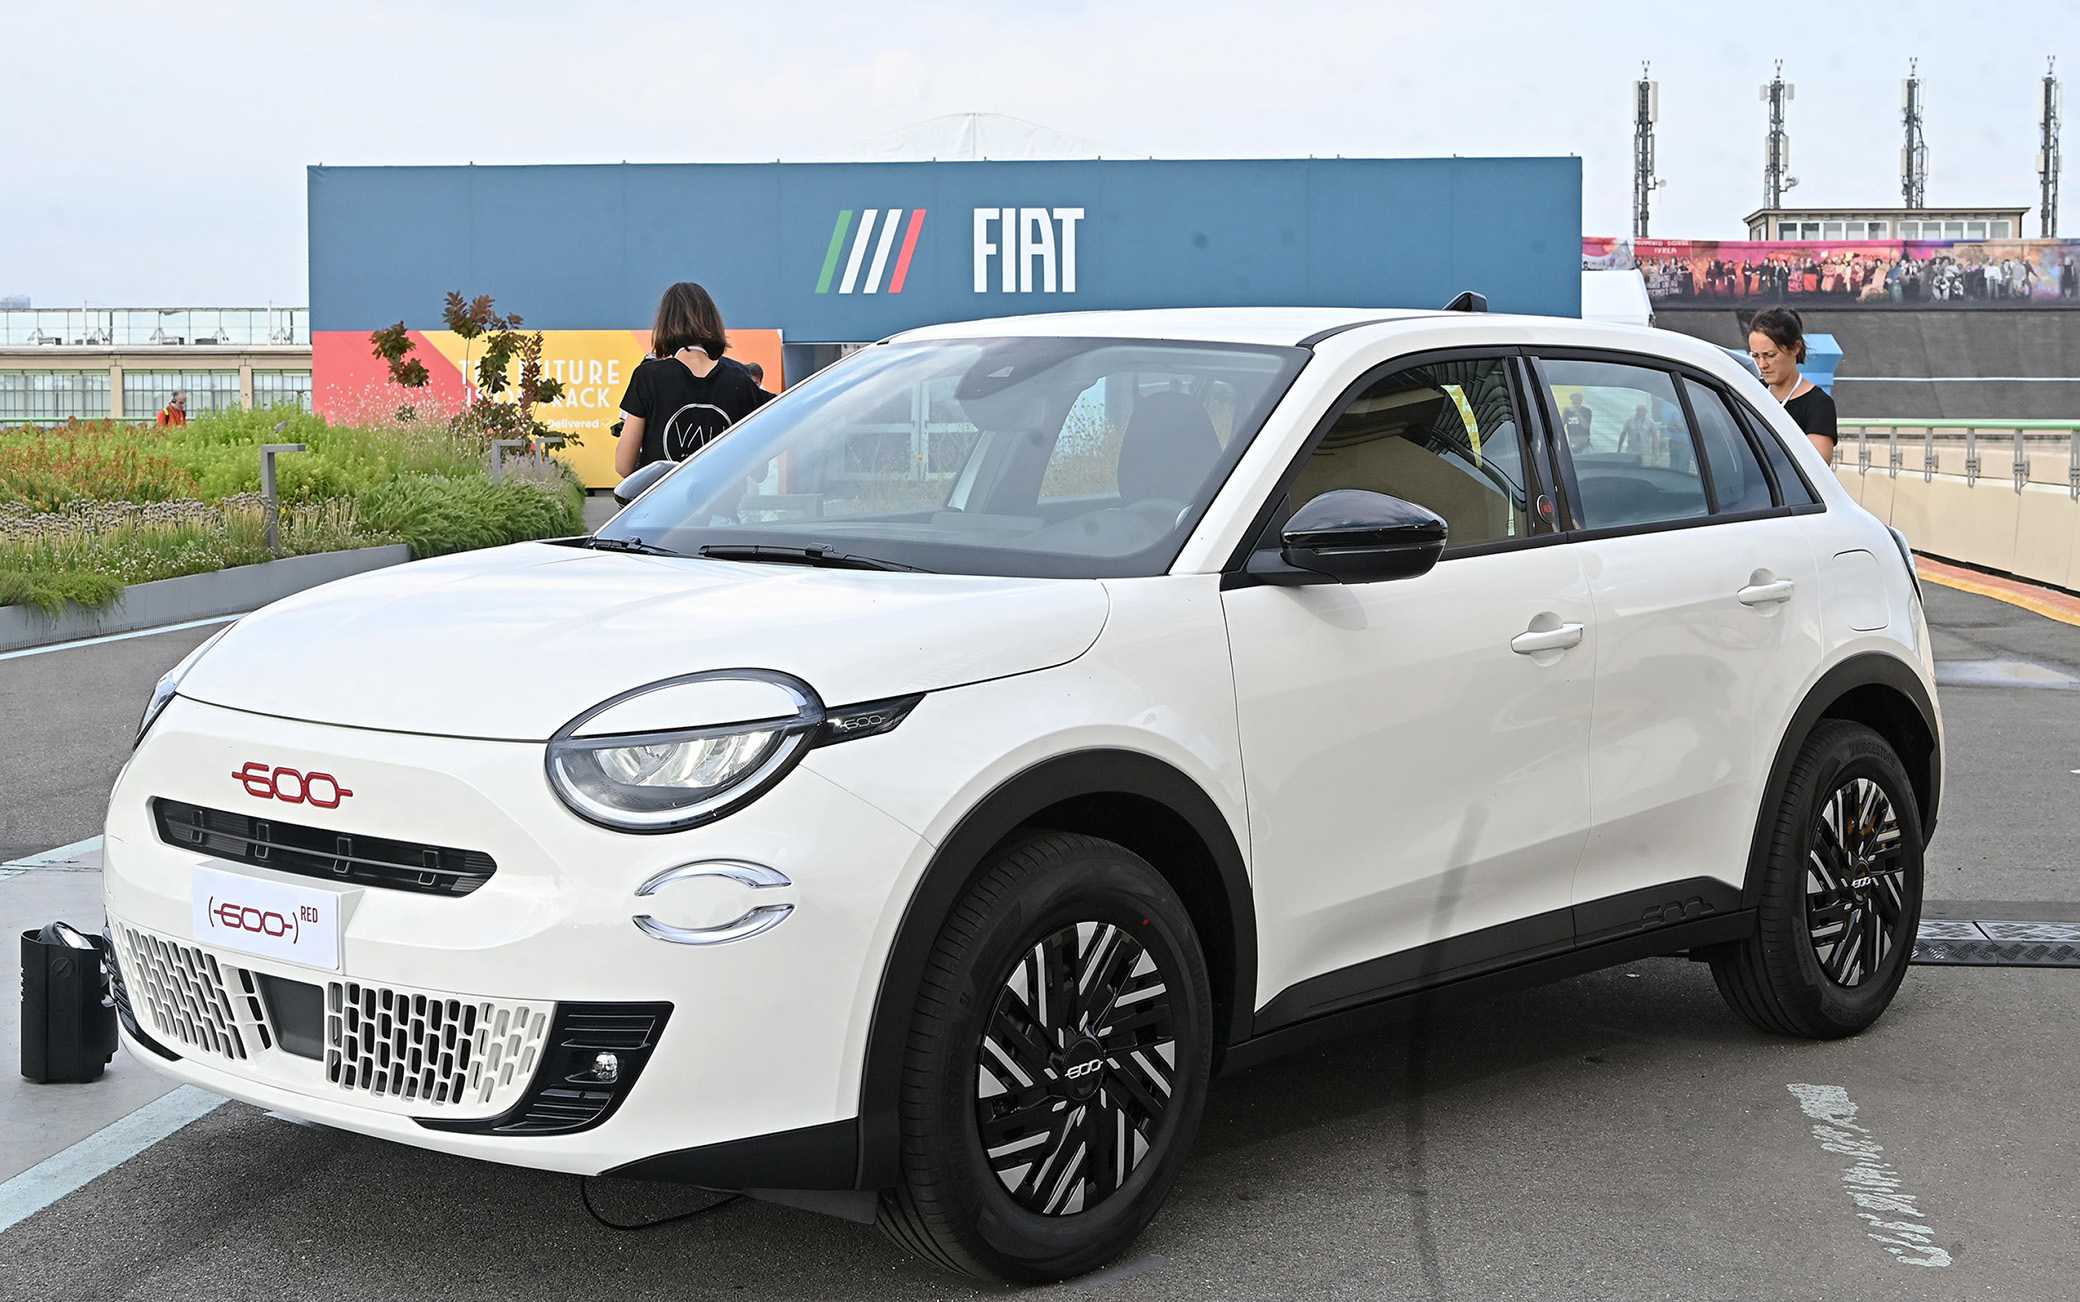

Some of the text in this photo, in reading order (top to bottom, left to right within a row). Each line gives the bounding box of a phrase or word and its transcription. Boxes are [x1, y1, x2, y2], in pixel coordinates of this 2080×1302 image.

[973, 207, 1085, 294] FIAT
[547, 418, 600, 429] Delivered
[231, 761, 354, 809] 600
[300, 905, 319, 924] RED
[1065, 1058, 1104, 1080] 600
